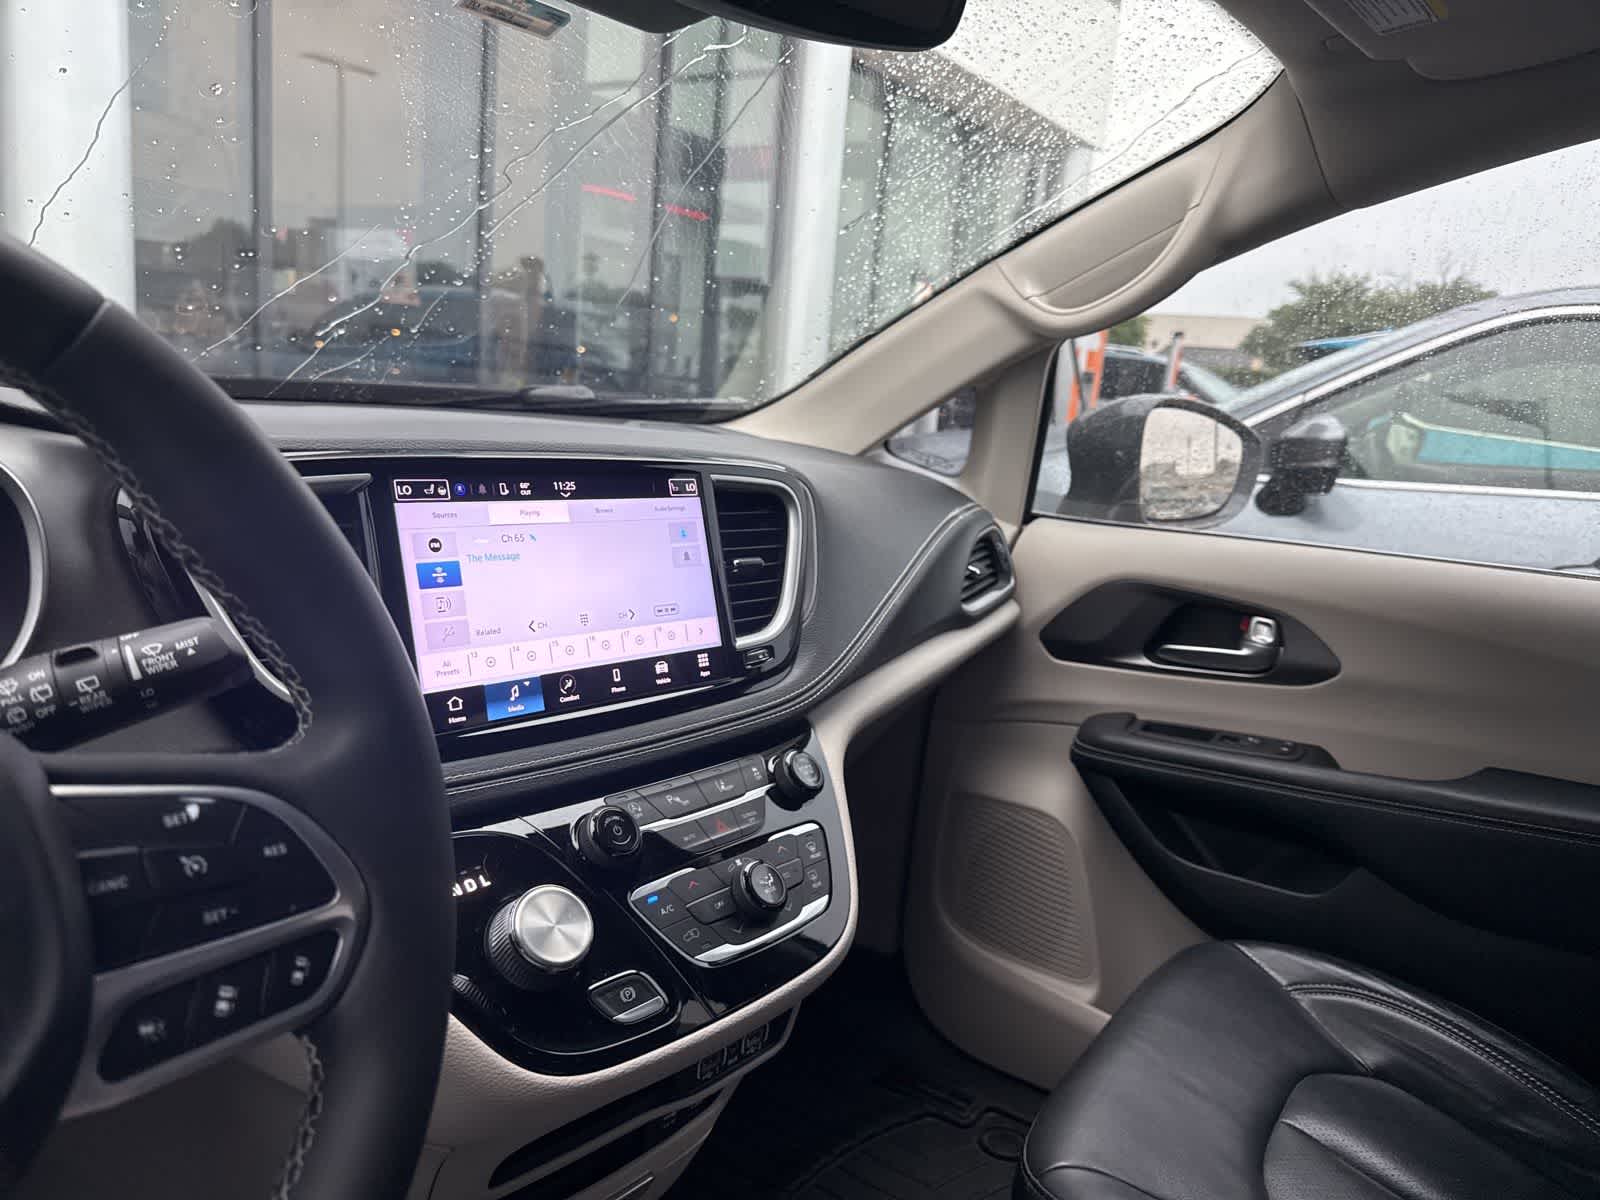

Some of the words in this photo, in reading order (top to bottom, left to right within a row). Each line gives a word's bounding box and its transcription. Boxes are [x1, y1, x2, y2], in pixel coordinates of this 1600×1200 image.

[397, 484, 412, 496] LO
[553, 482, 576, 490] 11:25
[685, 483, 696, 492] LO
[432, 511, 458, 520] Sources
[519, 509, 541, 518] Playing
[501, 535, 513, 543] Ch
[514, 534, 525, 542] 65
[466, 554, 483, 563] The
[485, 552, 521, 563] Message
[476, 627, 502, 637] Related
[175, 636, 199, 650] MIST
[141, 651, 175, 669] FRONT
[145, 660, 179, 676] WIPER
[28, 668, 46, 681] ON
[436, 669, 460, 678] Presets
[140, 688, 154, 697] LO
[36, 704, 56, 719] OFF
[508, 704, 525, 712] Media
[660, 904, 674, 916] A/C
